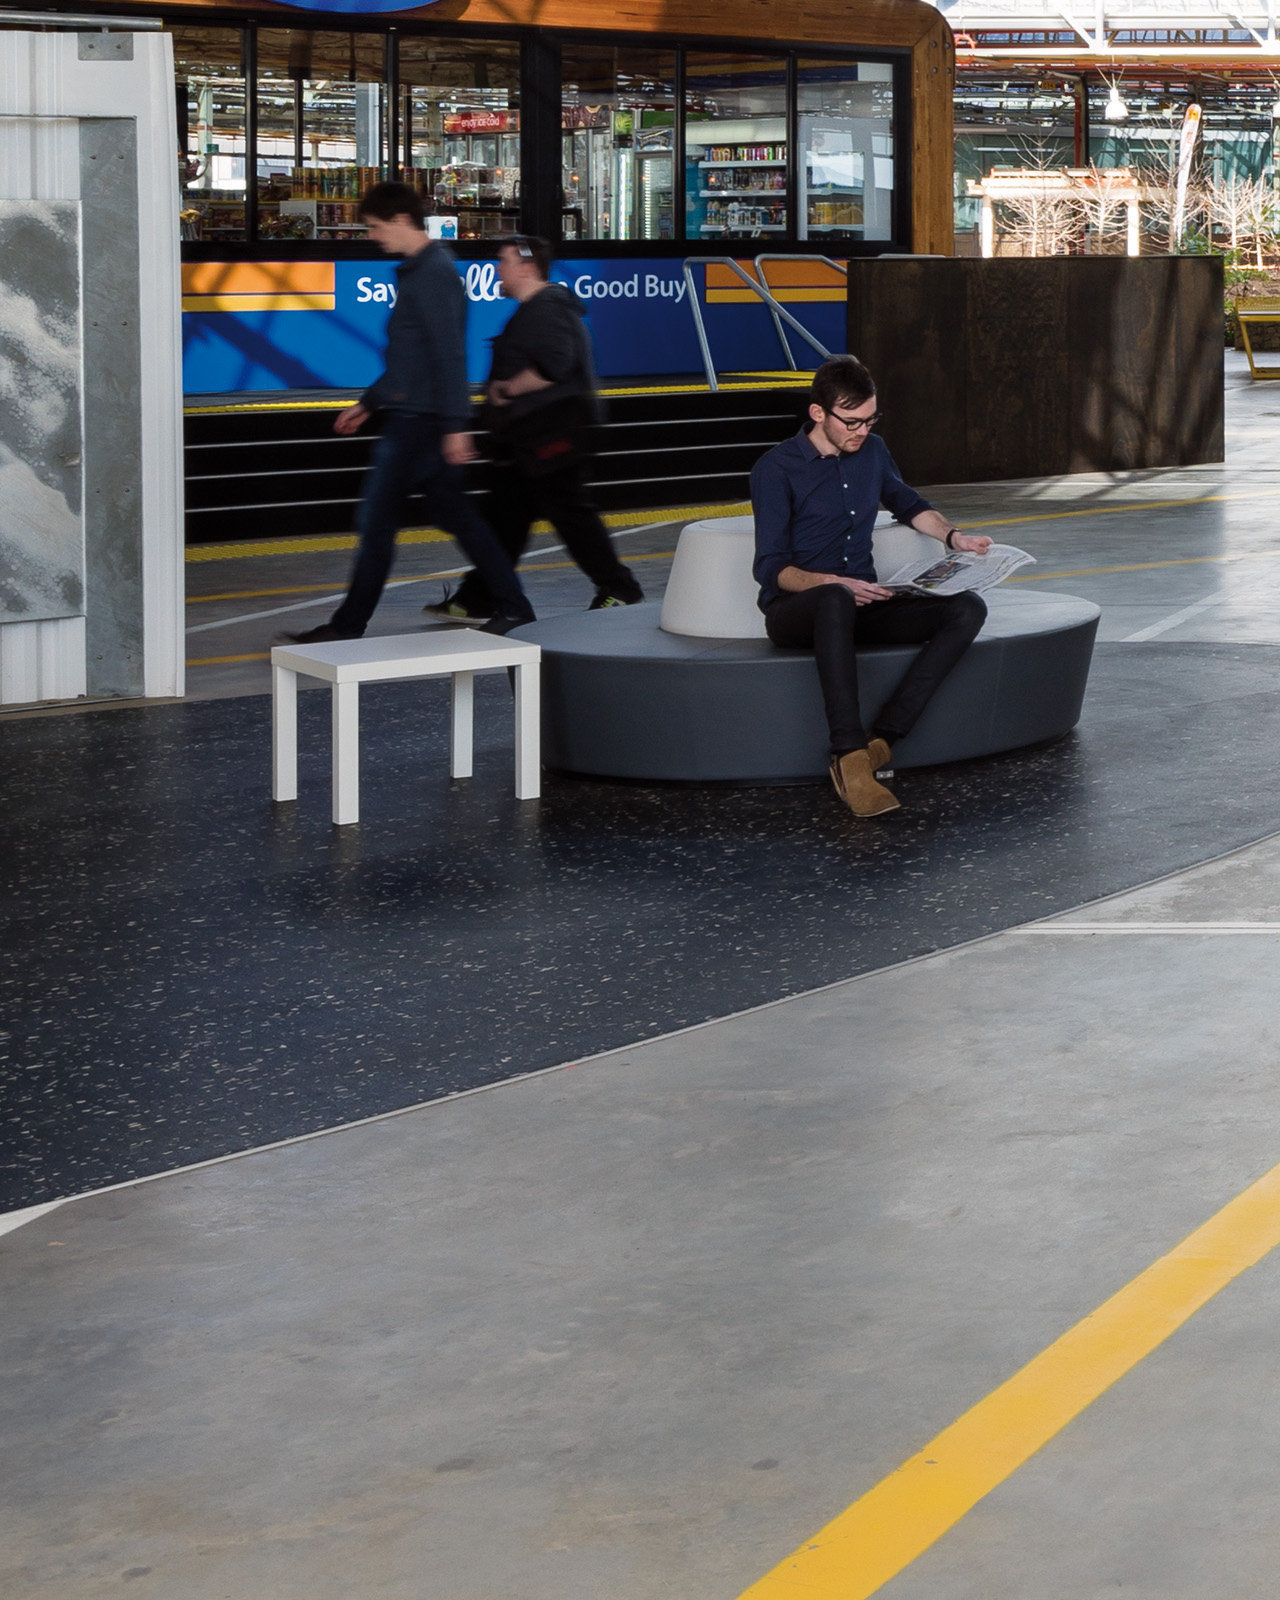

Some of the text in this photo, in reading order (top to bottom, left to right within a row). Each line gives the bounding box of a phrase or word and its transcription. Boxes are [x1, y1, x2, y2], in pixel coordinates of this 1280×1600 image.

[357, 276, 399, 309] Say
[574, 273, 638, 298] Good
[645, 274, 687, 303] Buy
